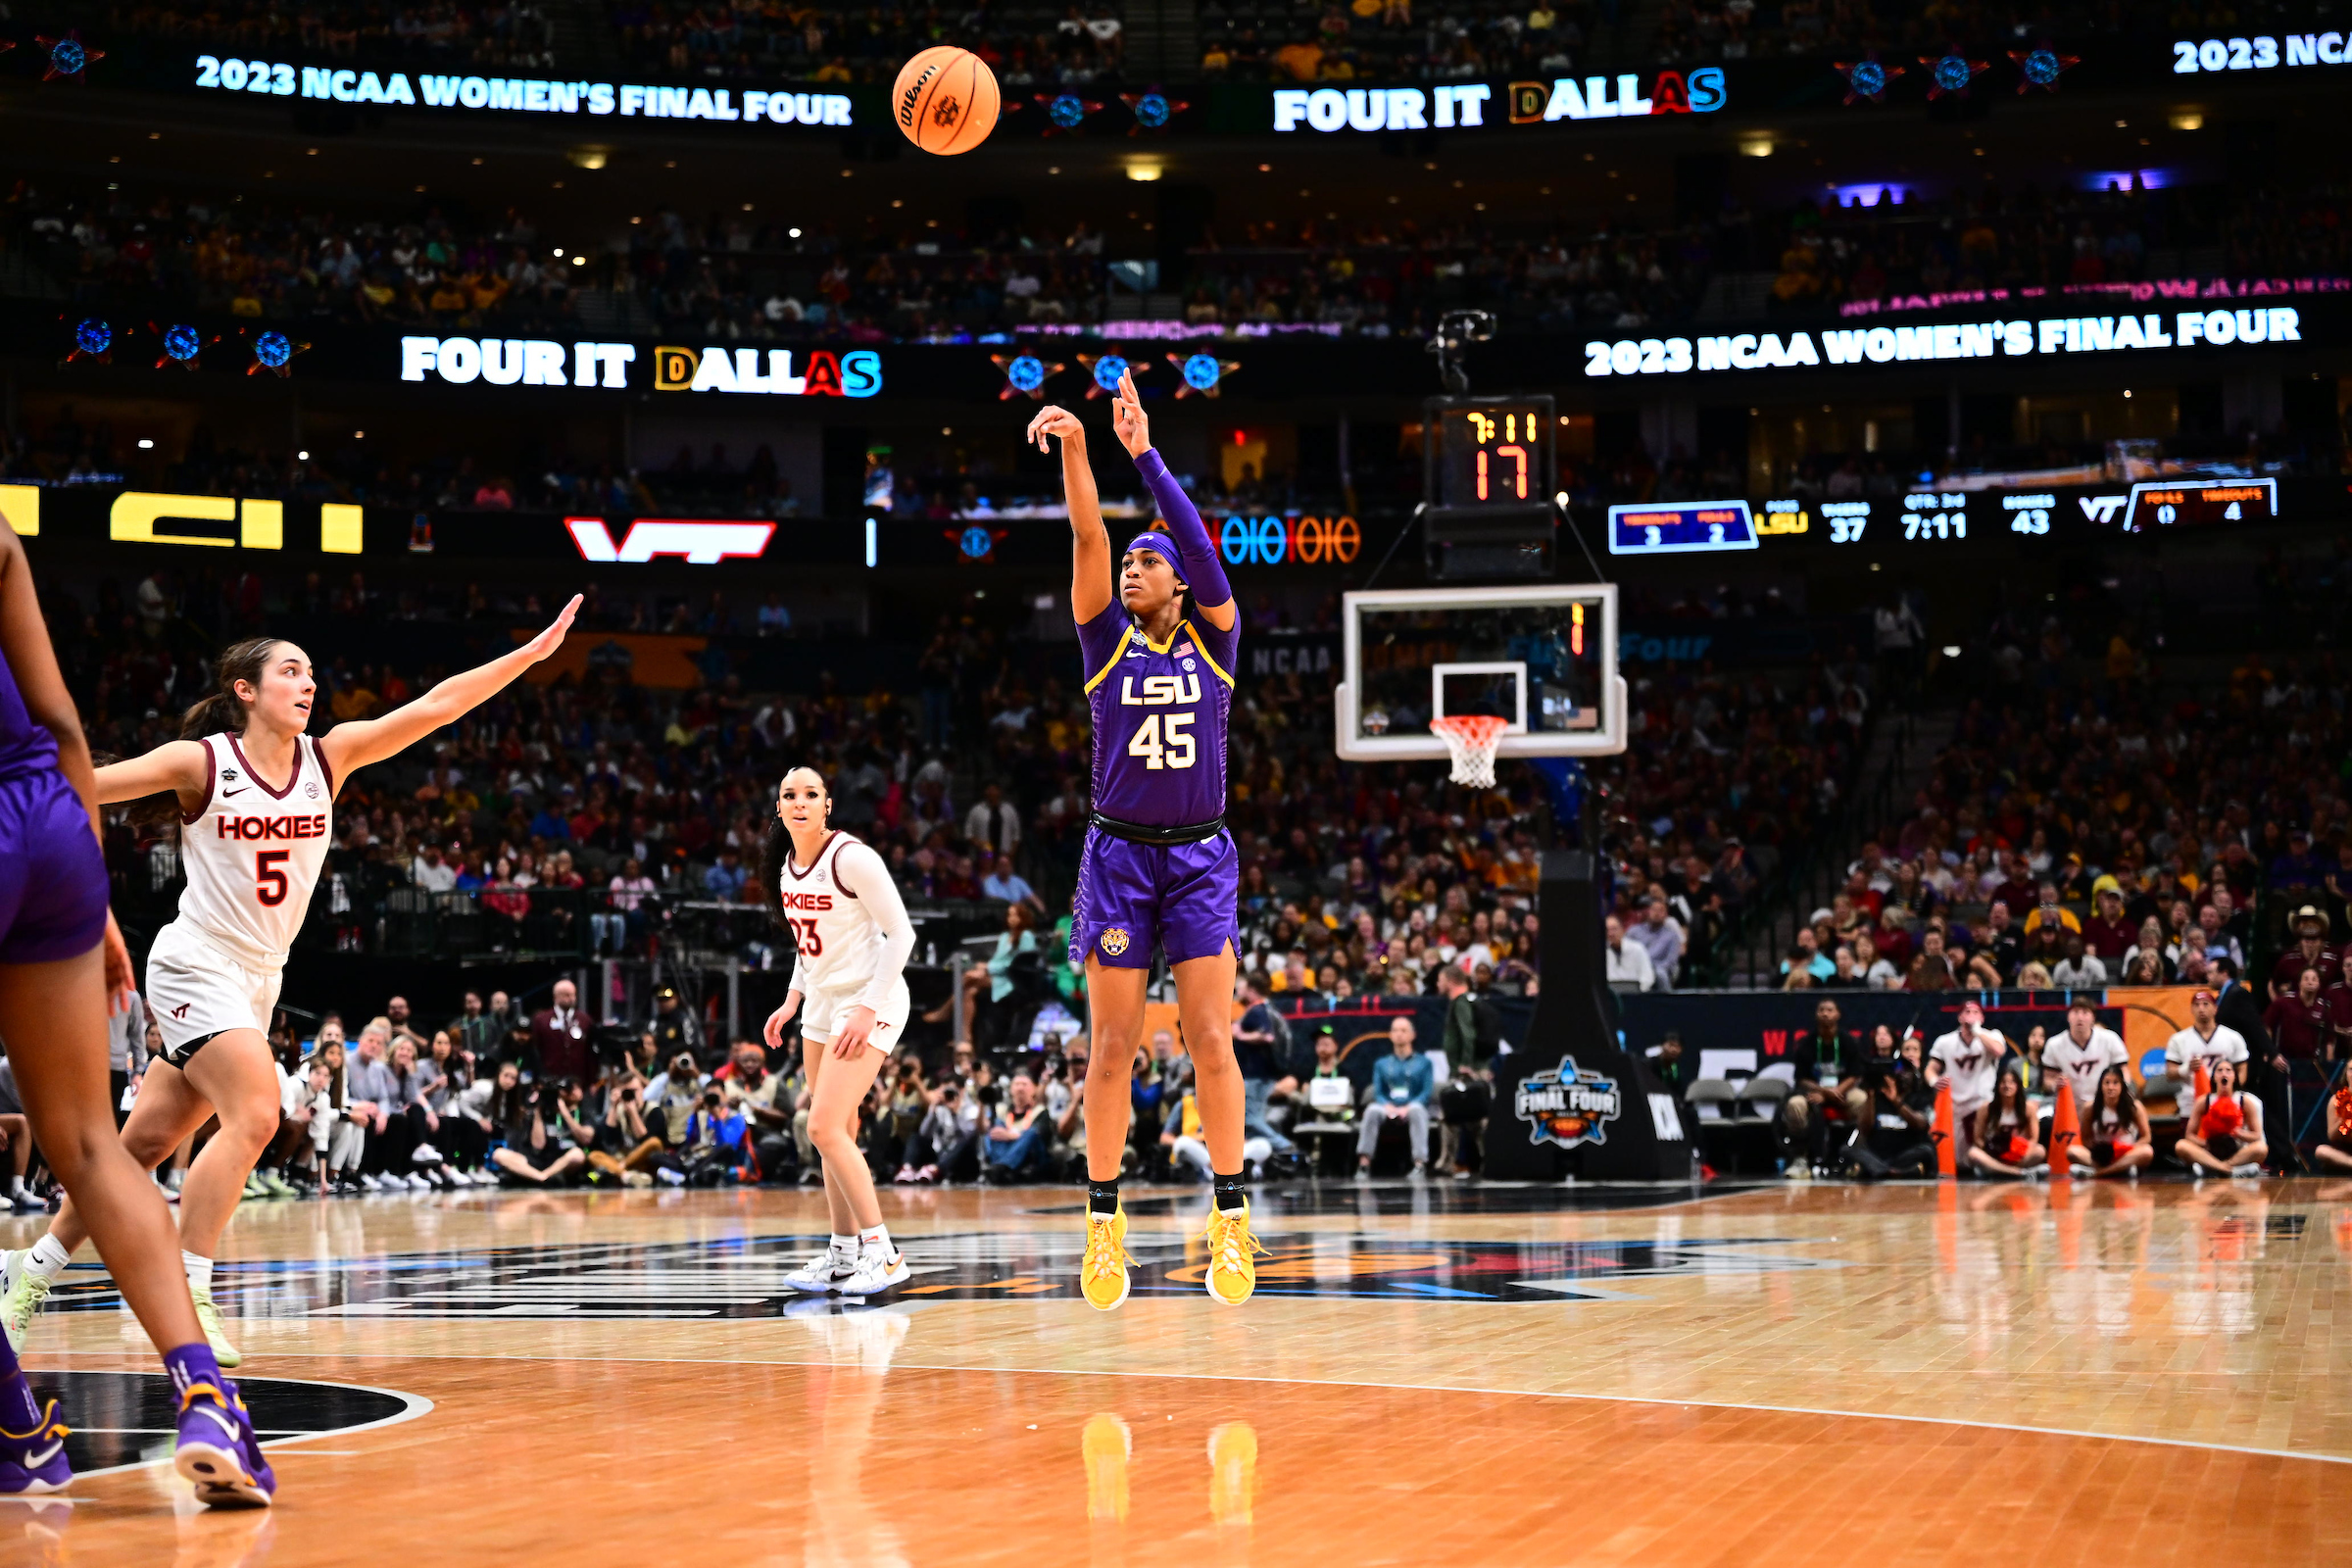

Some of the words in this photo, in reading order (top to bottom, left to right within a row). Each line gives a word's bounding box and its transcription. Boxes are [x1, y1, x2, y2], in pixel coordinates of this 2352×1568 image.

[2173, 35, 2280, 74] 2023
[196, 55, 296, 95] 2023
[302, 66, 416, 105] NCAA
[419, 75, 615, 115] WOMEN'S
[620, 84, 739, 121] FINAL
[743, 91, 853, 125] FOUR
[901, 65, 937, 127] Wilson
[1273, 85, 1428, 132] FOUR
[1434, 83, 1491, 127] IT
[1509, 67, 1728, 125] DALLAS
[1584, 336, 1693, 377] 2023
[1697, 330, 1821, 371] NCAA
[1823, 318, 2034, 365] WOMEN'S
[2038, 314, 2173, 354] FINAL
[2177, 307, 2302, 347] FOUR
[400, 335, 568, 386] FOUR
[574, 341, 636, 388] IT
[654, 346, 883, 399] DALLAS
[1467, 412, 1537, 445] 7:11
[1476, 445, 1528, 501] 17
[2011, 510, 2050, 535] 43
[2079, 494, 2128, 523] VT
[1644, 523, 1662, 546] 3
[1708, 522, 1726, 545] 2
[1754, 512, 1808, 535] LSU
[1830, 517, 1867, 543] 37
[1900, 513, 1966, 540] 7:11
[564, 516, 777, 564] VT
[1251, 647, 1331, 675] NCAA
[1120, 673, 1202, 706] LSU
[1127, 711, 1197, 770] 45
[218, 813, 326, 841] HOKIES
[256, 849, 290, 908] 5
[781, 891, 833, 911] OKIES
[171, 1002, 191, 1019] VT
[1954, 1054, 1982, 1071] VT
[2070, 1058, 2100, 1076] VT
[1519, 1091, 1566, 1113] FINAL
[1570, 1091, 1615, 1113] FOUR
